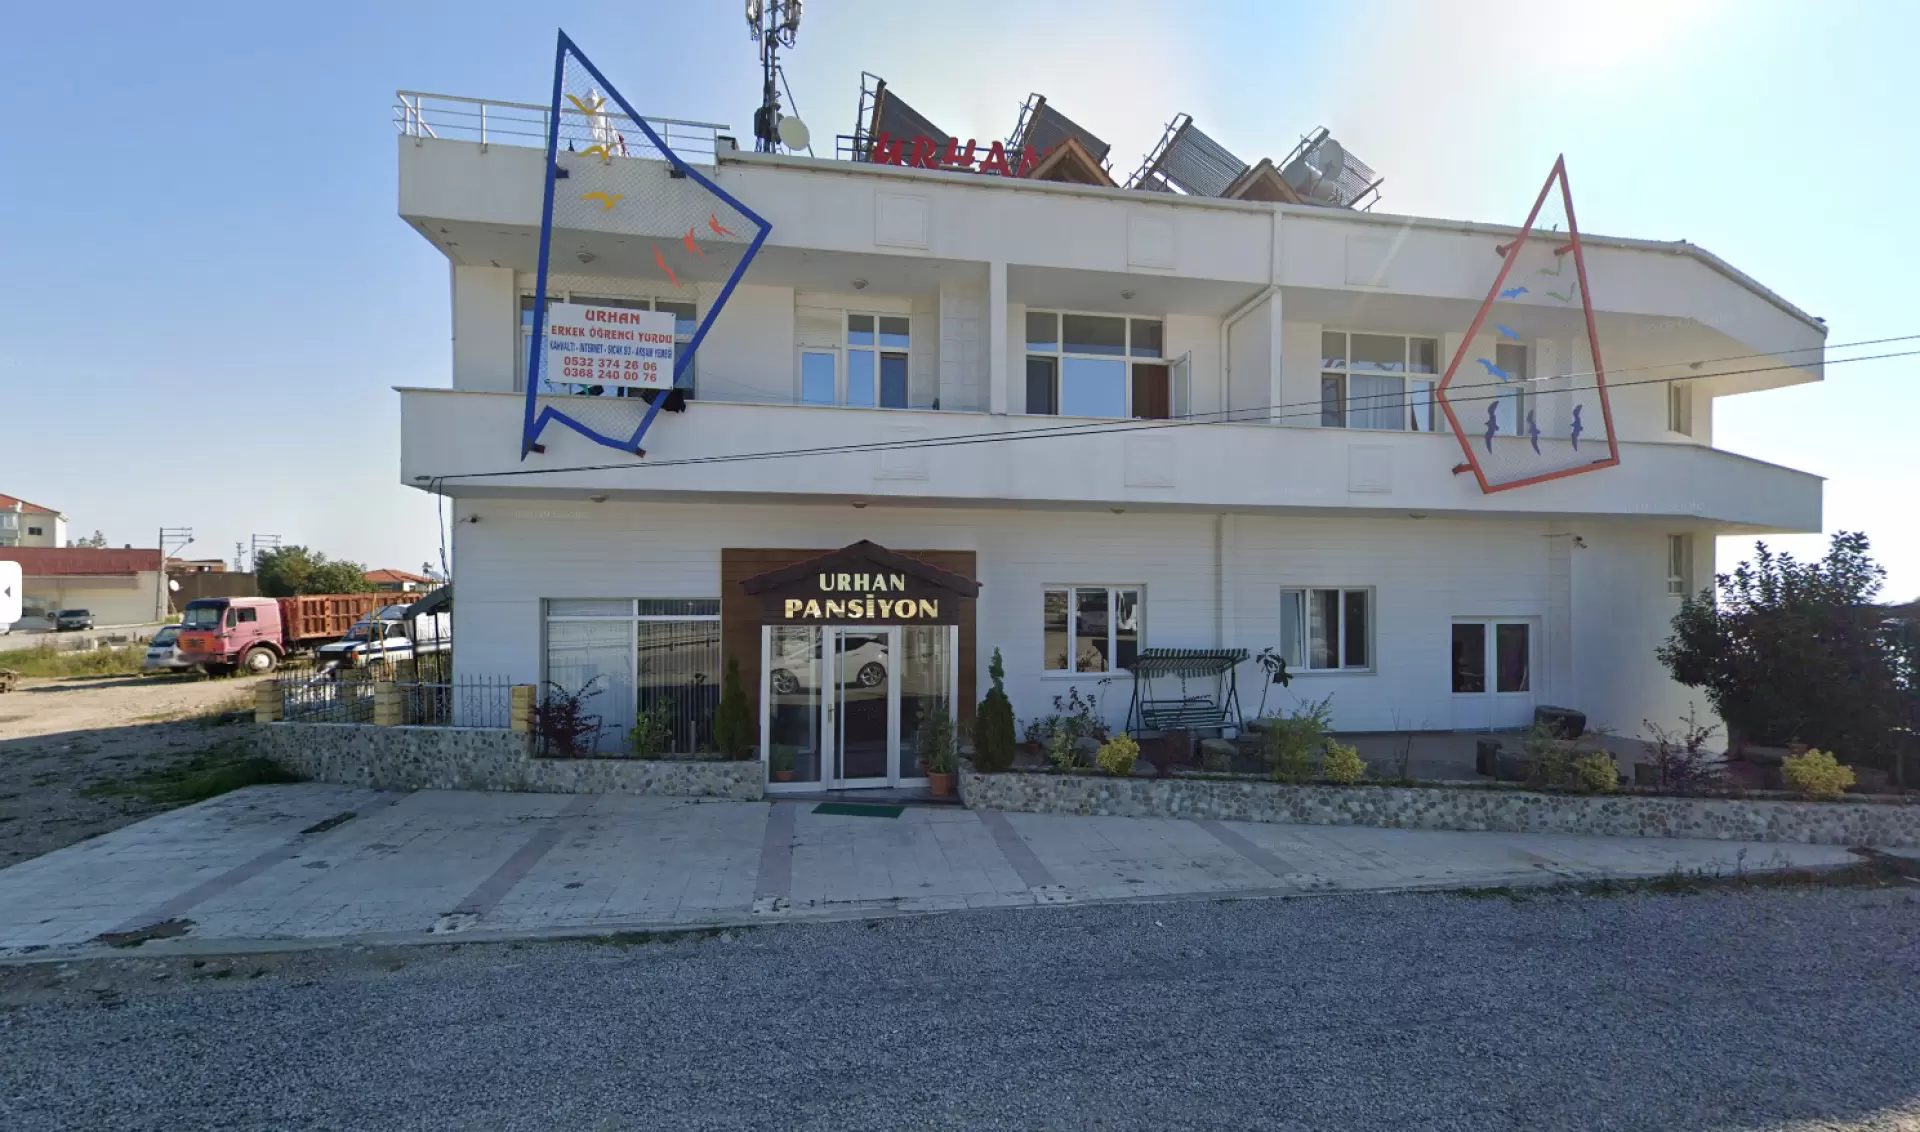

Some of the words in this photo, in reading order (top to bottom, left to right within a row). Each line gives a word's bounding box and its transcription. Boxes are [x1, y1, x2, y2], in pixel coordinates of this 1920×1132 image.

[585, 309, 640, 325] URHAN
[551, 325, 585, 337] ERKEK
[638, 332, 672, 344] YURDU
[564, 356, 594, 367] 0532
[598, 358, 620, 369] 374
[643, 362, 657, 372] 06
[564, 367, 593, 378] 0368
[598, 369, 620, 380] 240
[624, 371, 639, 381] 00
[643, 373, 657, 382] 76
[819, 573, 905, 592] URHAN
[784, 594, 939, 619] PANSİYON
